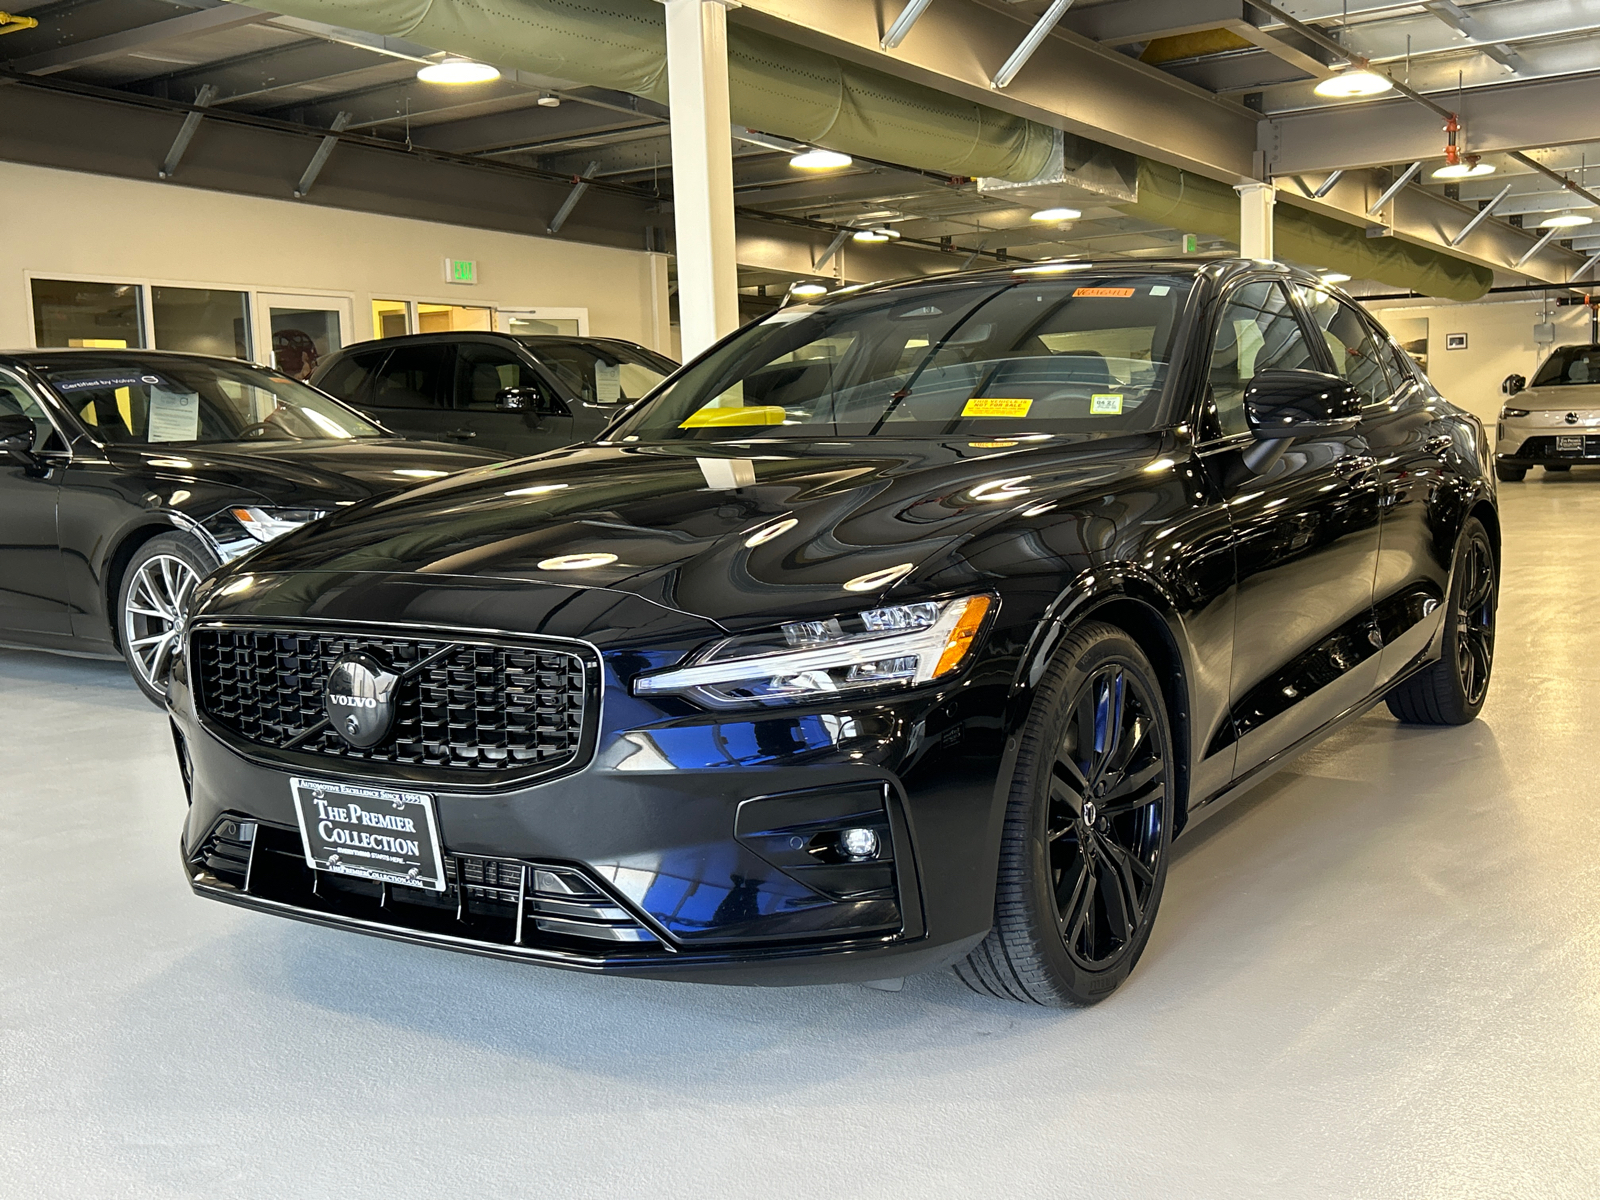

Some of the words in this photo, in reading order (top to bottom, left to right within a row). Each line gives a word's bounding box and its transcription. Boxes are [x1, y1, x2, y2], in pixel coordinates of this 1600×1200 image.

[454, 261, 473, 280] EXIT
[62, 381, 99, 389] Certified
[330, 694, 377, 708] VOLVO
[340, 785, 379, 798] EXCELLENCE
[380, 791, 400, 801] SINCE
[314, 799, 348, 823] THE
[348, 803, 416, 833] PREMIER
[318, 820, 420, 856] COLLECTION
